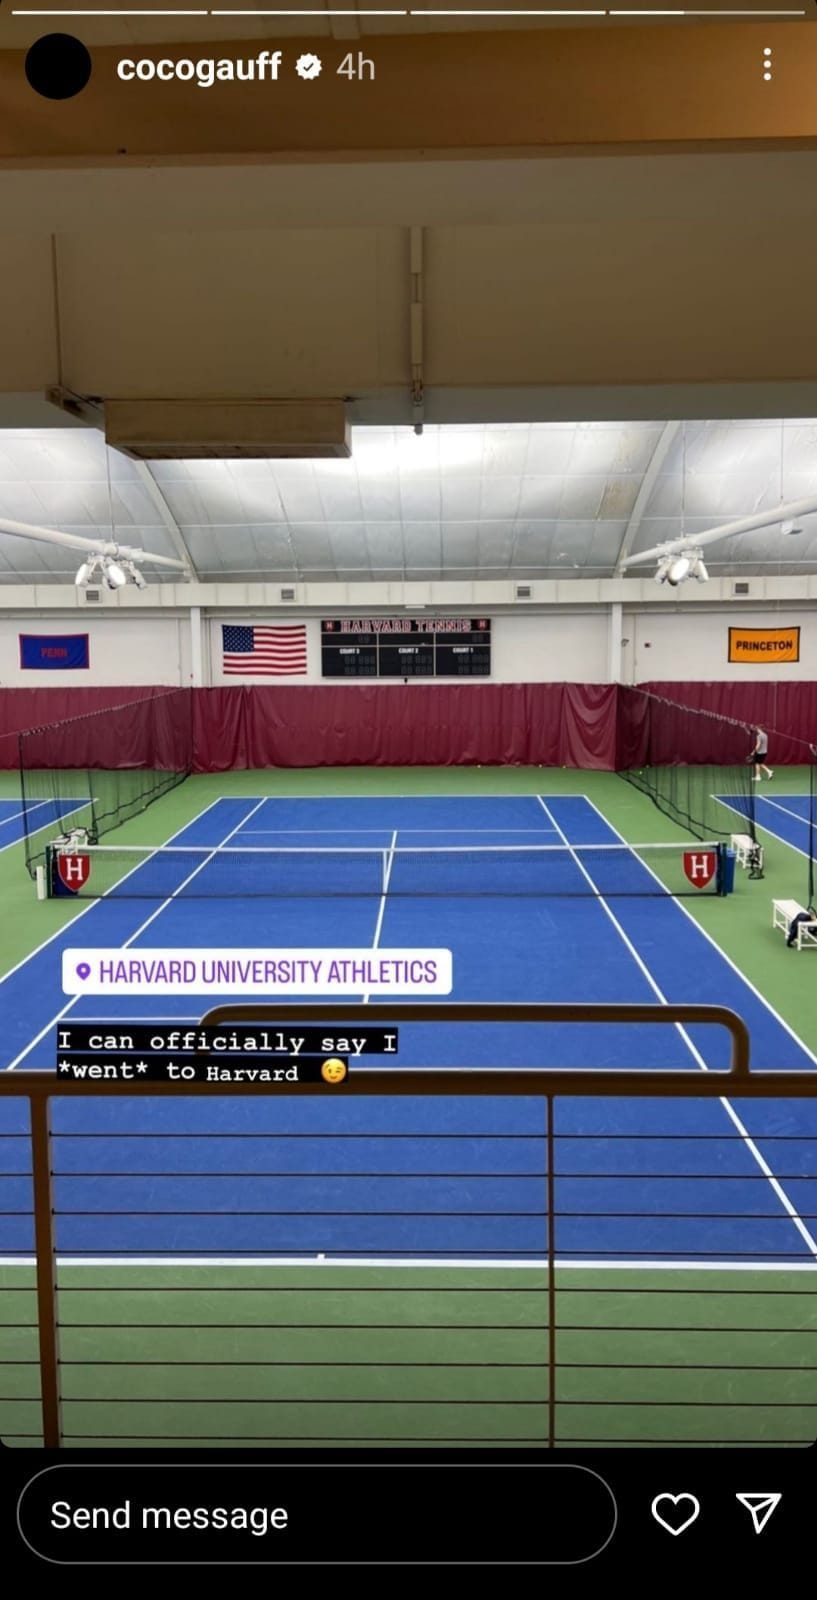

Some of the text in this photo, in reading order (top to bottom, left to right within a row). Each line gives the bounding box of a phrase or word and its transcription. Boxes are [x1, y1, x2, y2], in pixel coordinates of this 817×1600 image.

[340, 620, 471, 632] HARVARD TENNIS
[736, 640, 793, 651] PRINCETON
[66, 857, 83, 881] H
[691, 855, 709, 878] H
